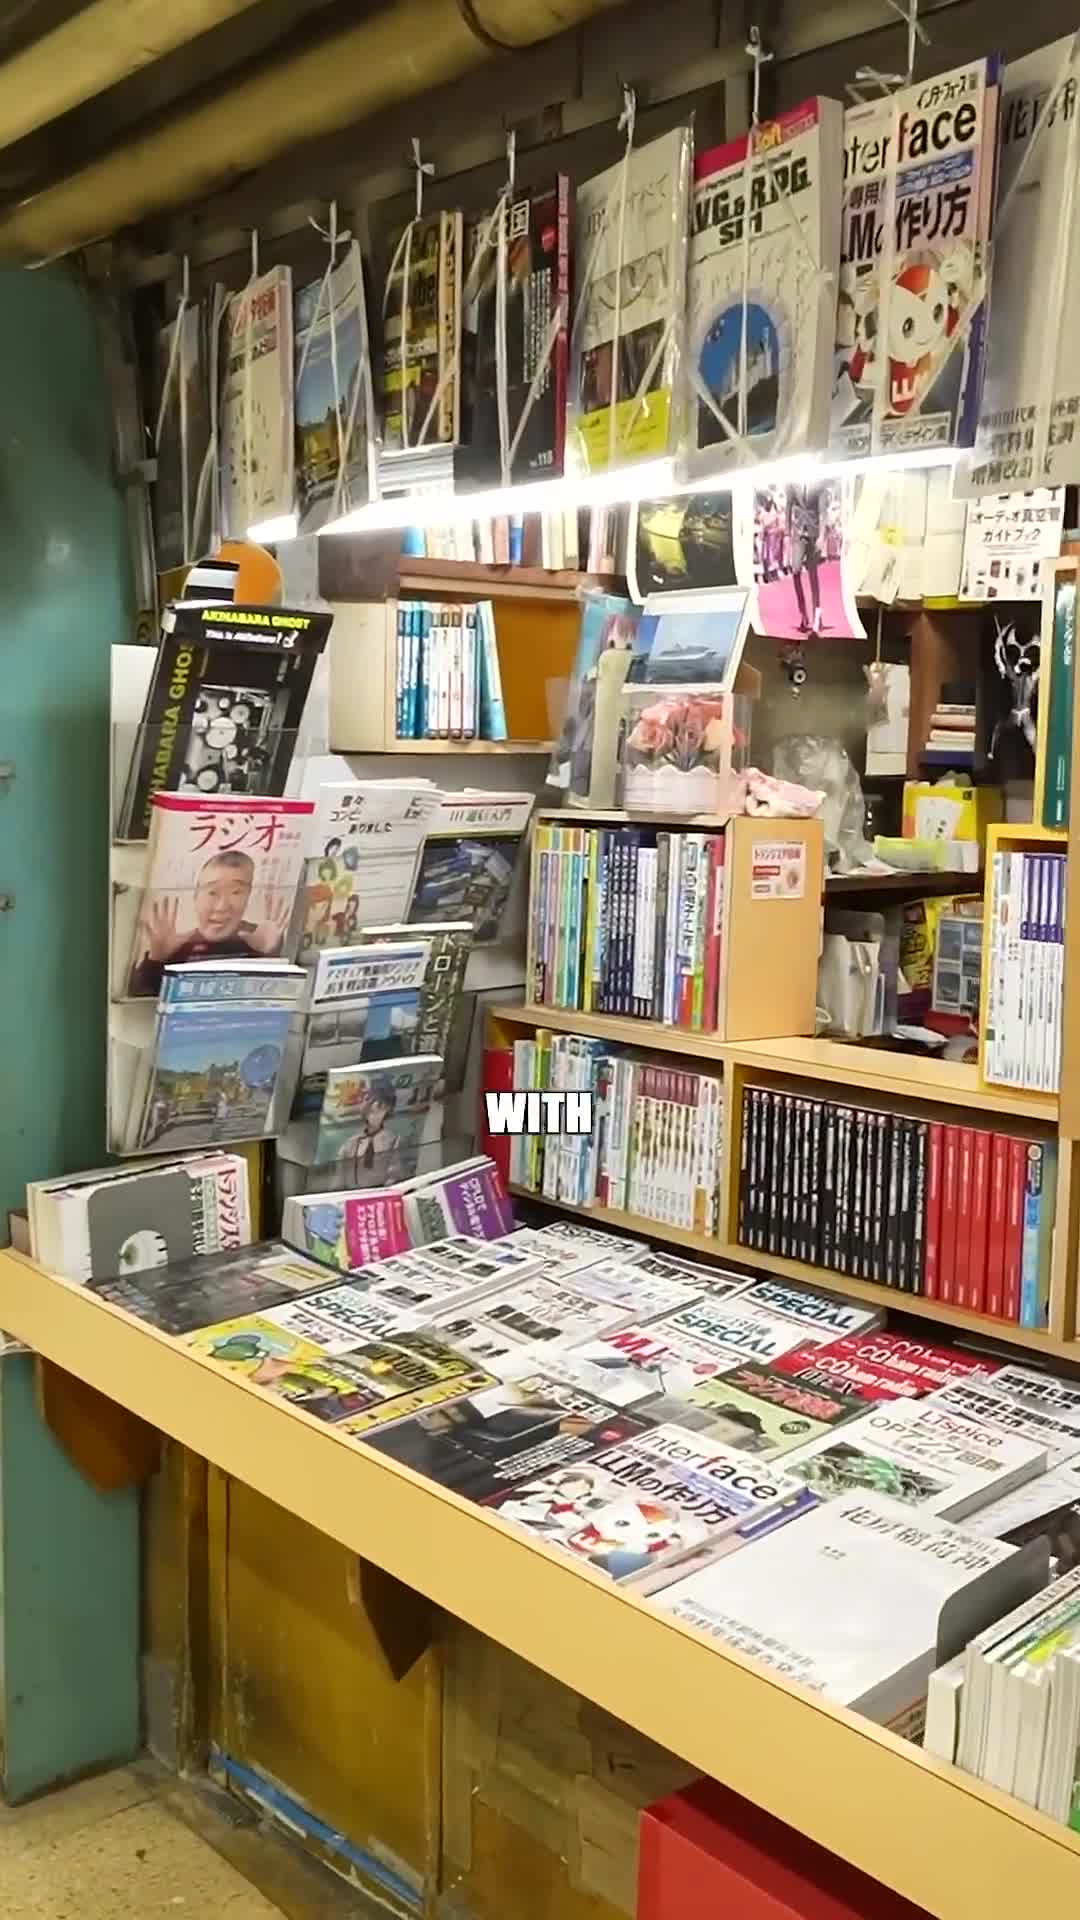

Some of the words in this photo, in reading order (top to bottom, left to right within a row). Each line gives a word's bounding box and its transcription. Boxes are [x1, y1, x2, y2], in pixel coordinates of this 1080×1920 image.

[201, 609, 270, 627] AKIHABARA
[271, 615, 311, 631] GHOST
[190, 815, 285, 852] ラジオ
[748, 1286, 857, 1331] SPECIAL
[673, 1311, 778, 1358] SPECIAL
[917, 1409, 1004, 1448] LTspice
[587, 1449, 739, 1526] LLMの作り方
